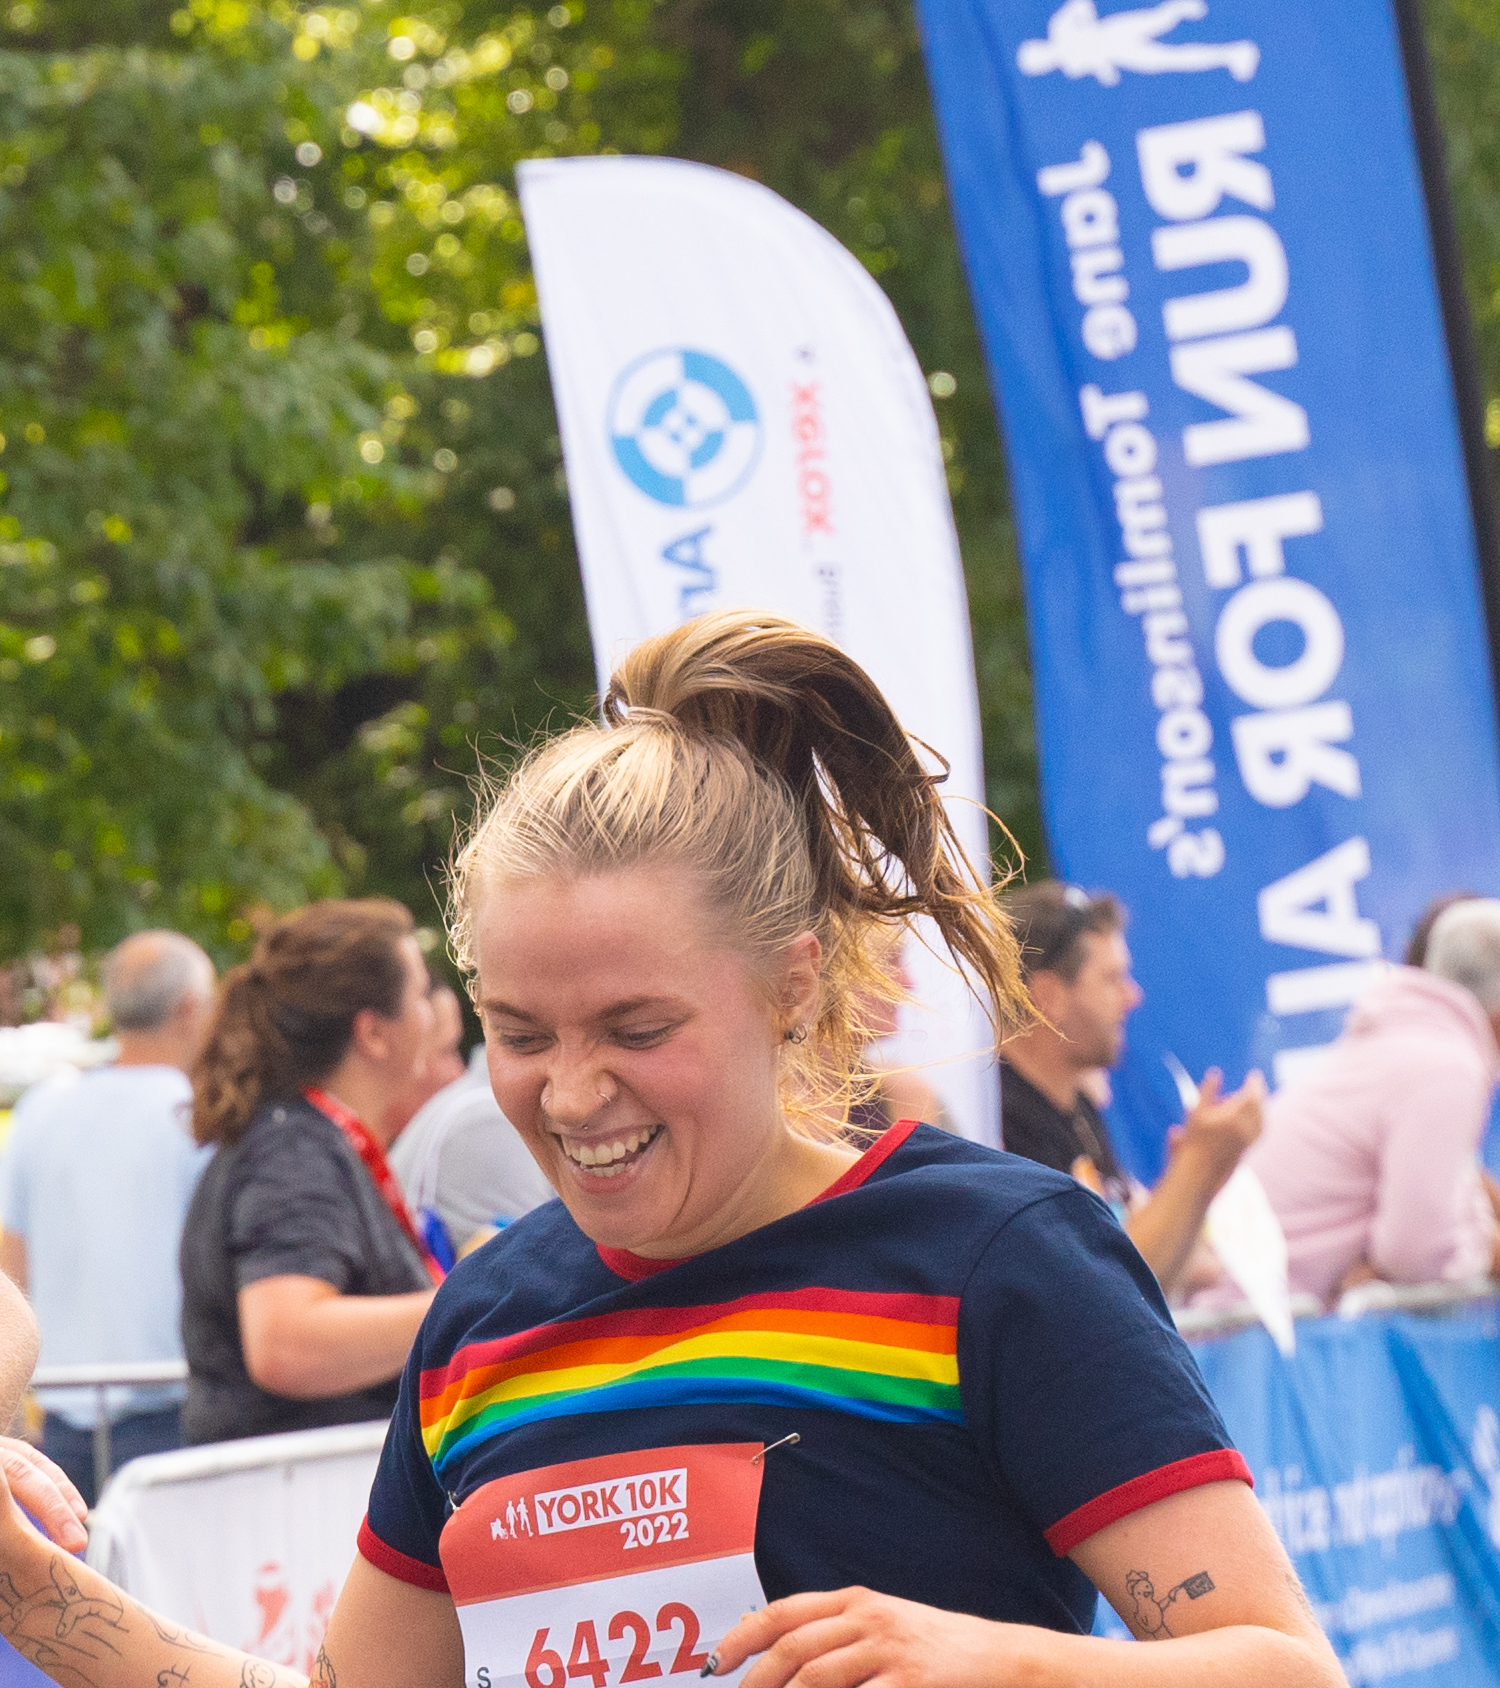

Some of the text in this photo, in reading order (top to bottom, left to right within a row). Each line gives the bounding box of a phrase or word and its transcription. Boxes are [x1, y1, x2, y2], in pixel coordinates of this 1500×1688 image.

[537, 1473, 682, 1530] YORK 10K
[619, 1511, 690, 1550] 2022
